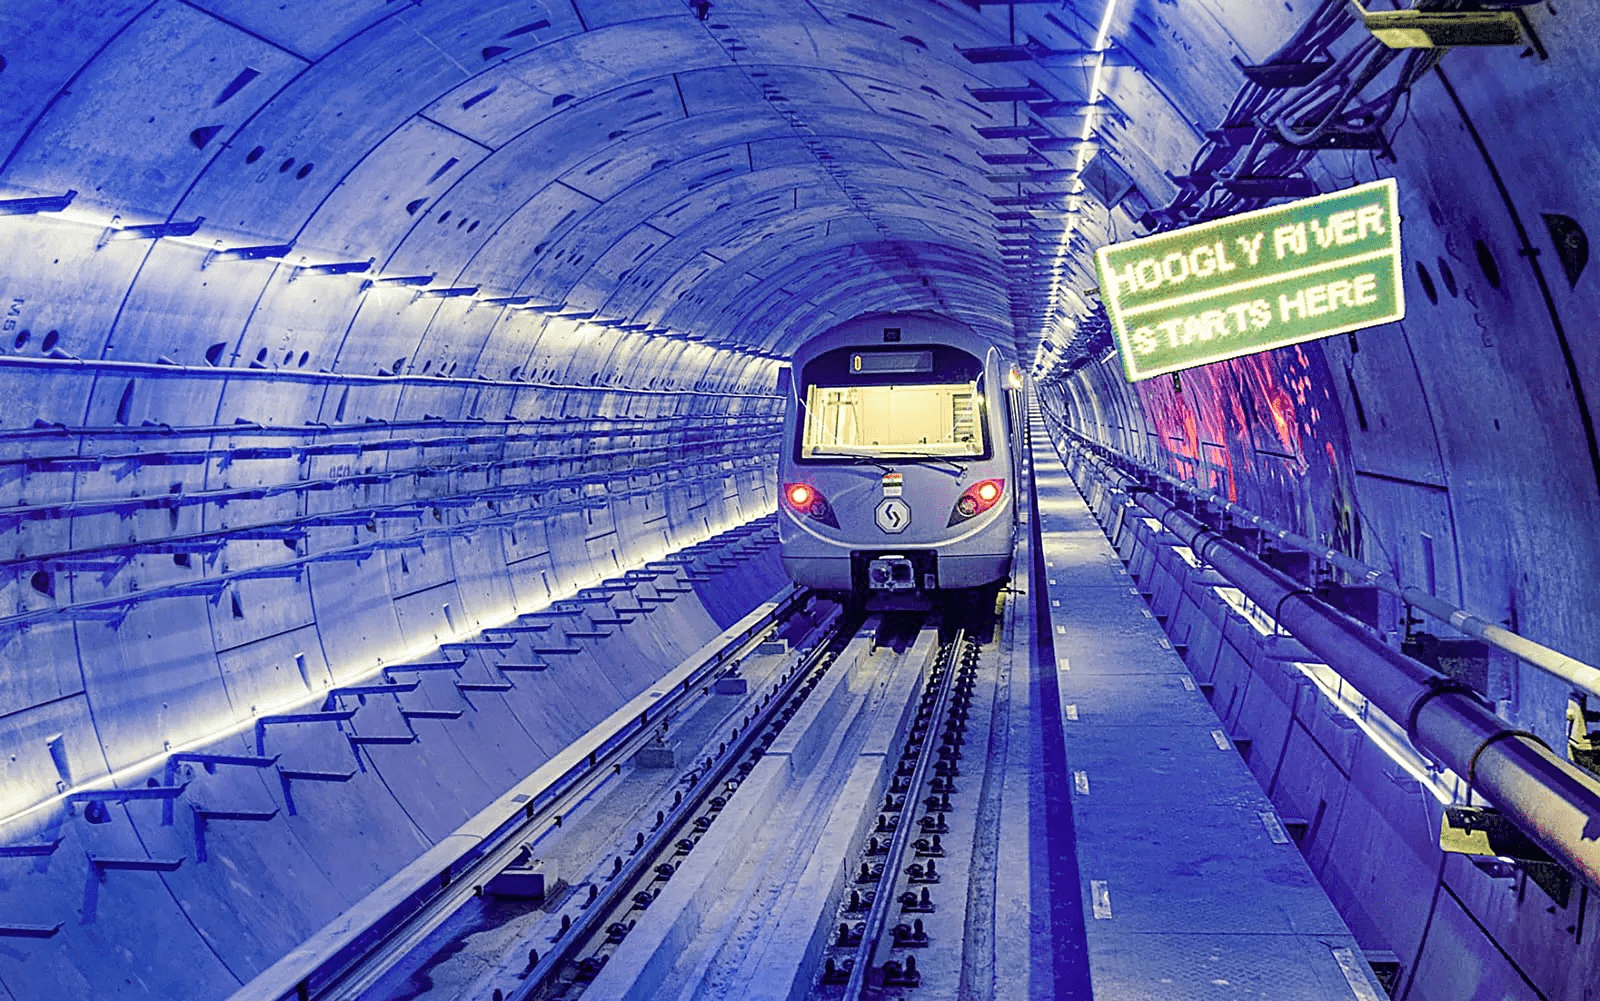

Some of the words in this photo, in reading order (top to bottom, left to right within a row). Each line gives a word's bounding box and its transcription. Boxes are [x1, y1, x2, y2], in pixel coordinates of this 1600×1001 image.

[1108, 231, 1265, 295] HOOGLY
[1273, 203, 1386, 259] RIVER
[1132, 299, 1272, 354] STARTS
[1278, 273, 1377, 323] HERE
